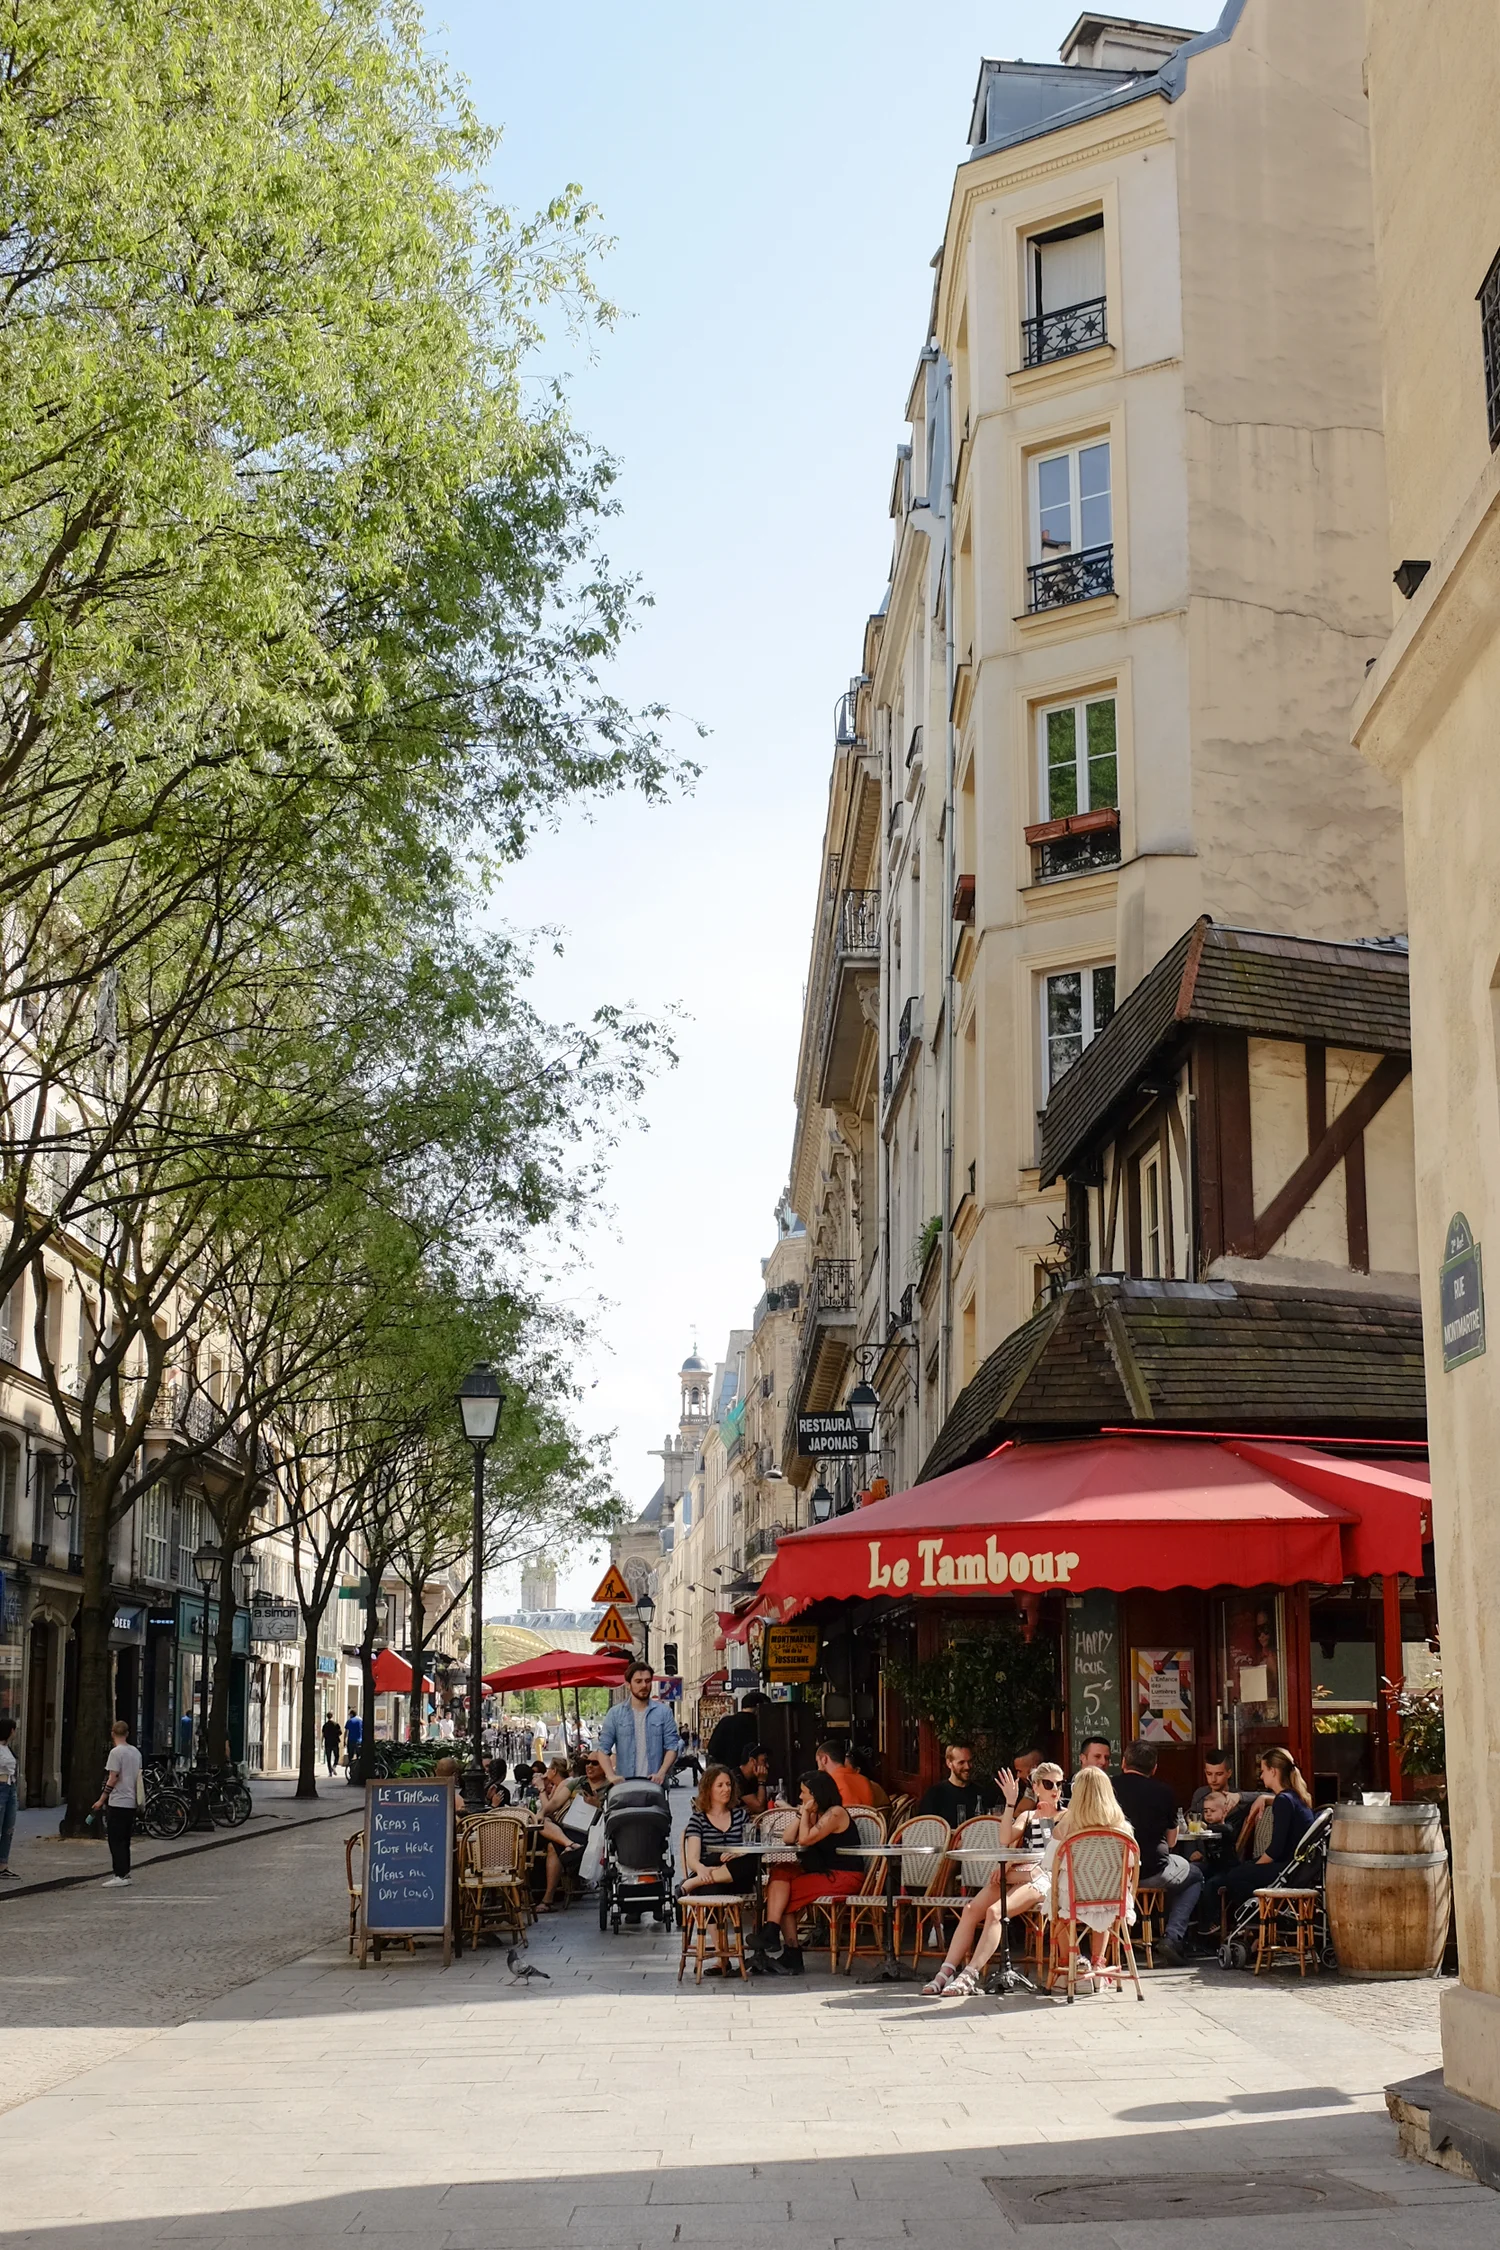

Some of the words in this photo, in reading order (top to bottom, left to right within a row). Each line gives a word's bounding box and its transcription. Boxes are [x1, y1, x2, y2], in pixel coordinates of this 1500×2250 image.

[1453, 1275, 1466, 1300] RUE
[1444, 1309, 1480, 1345] MONTMARTRE
[799, 1417, 853, 1433] RESTAURA
[808, 1435, 859, 1451] JAPONAIS
[867, 1541, 910, 1589] Le
[917, 1534, 1080, 1587] Tambour
[254, 1607, 297, 1618] a.simon
[1075, 1629, 1113, 1656] HAPPY
[774, 1655, 809, 1664] JUSSIENNE
[1074, 1657, 1107, 1675] HOUR
[378, 1788, 391, 1802] LE
[395, 1789, 440, 1804] TAMBOUR
[375, 1813, 407, 1832] REPAS
[373, 1839, 400, 1855] TOUTE
[405, 1841, 435, 1854] HEURE
[409, 1868, 427, 1878] ALL
[379, 1887, 398, 1901] DAY
[403, 1886, 435, 1901] LONG)
